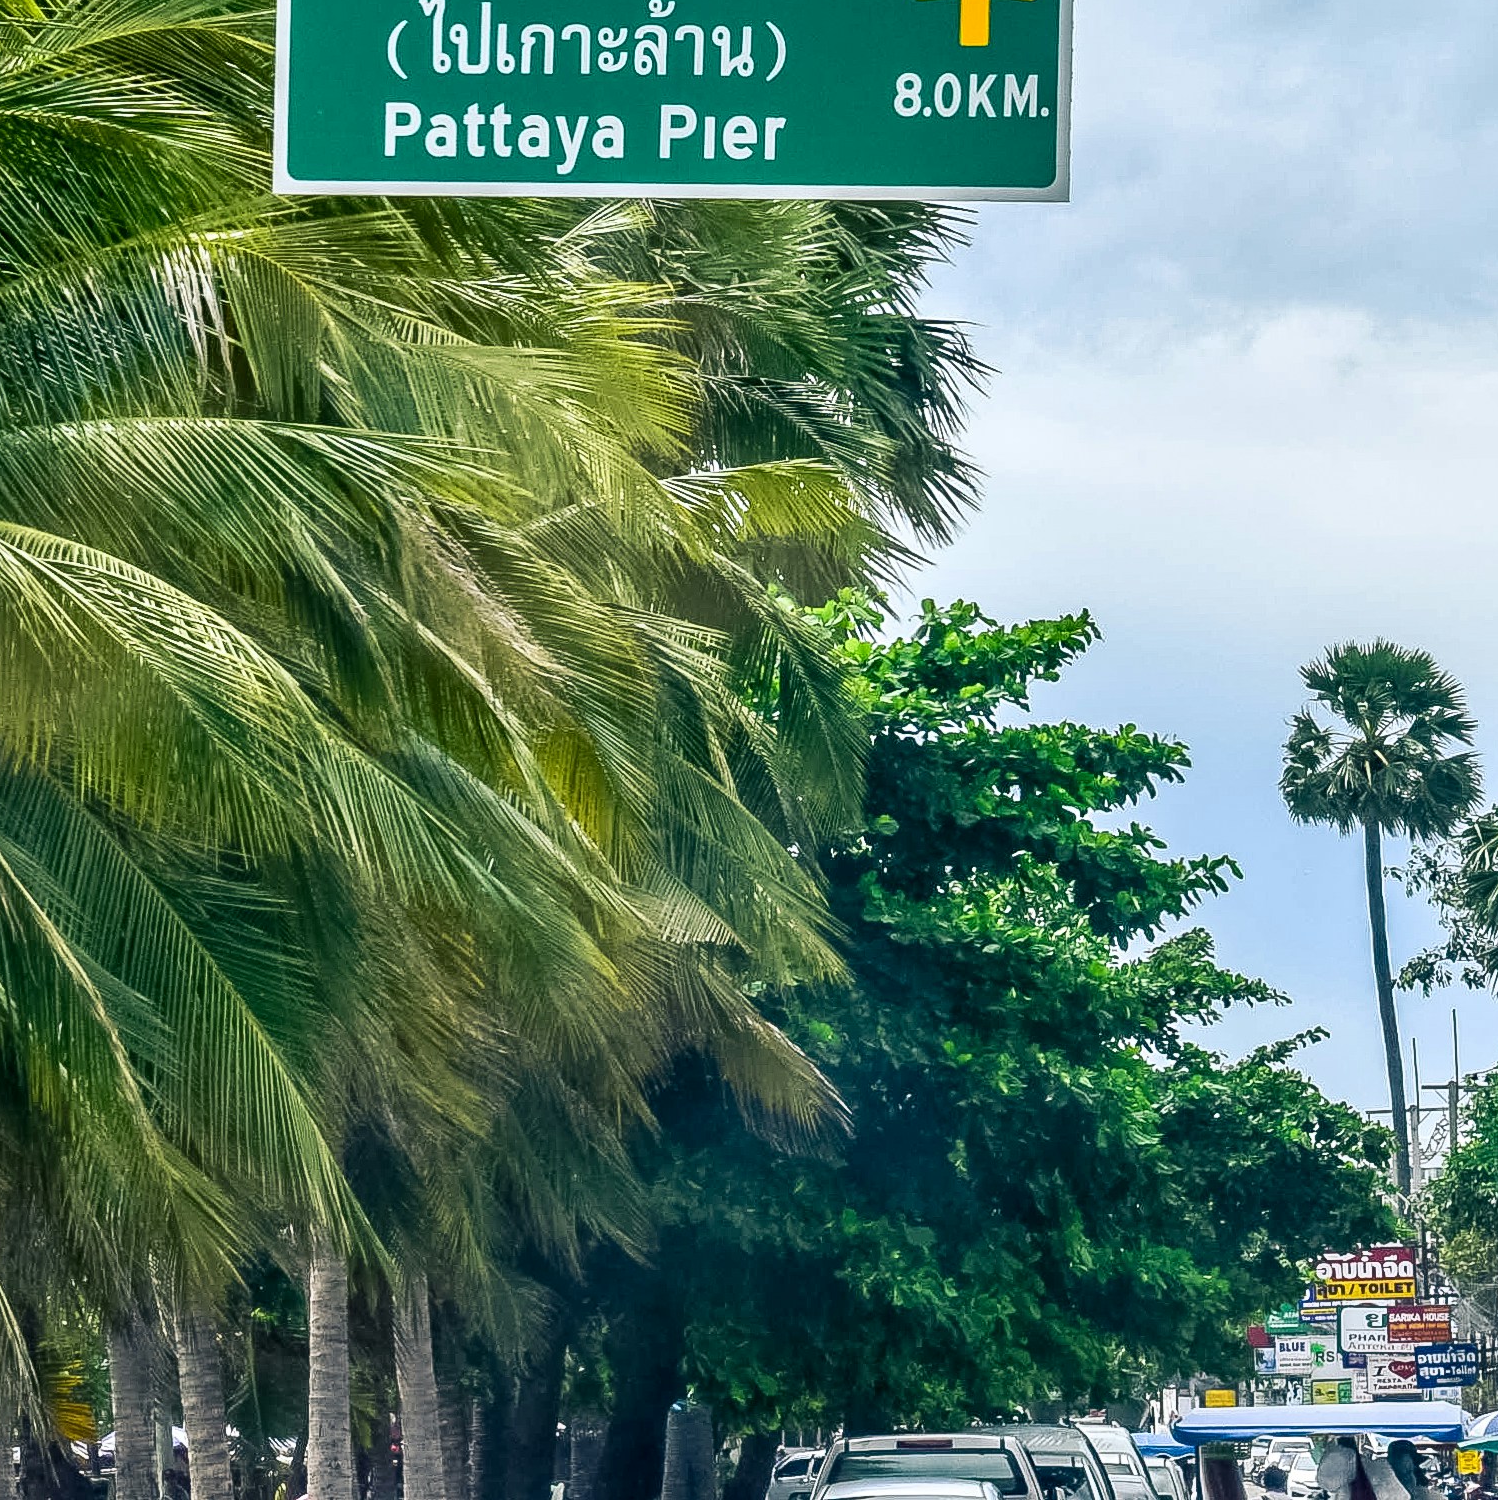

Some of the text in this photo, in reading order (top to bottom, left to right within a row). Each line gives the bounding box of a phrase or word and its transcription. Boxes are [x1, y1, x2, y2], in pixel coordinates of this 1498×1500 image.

[893, 73, 1050, 118] 8.0KM.
[383, 103, 786, 175] Pattaya Pier
[1359, 1282, 1413, 1295] TOILET
[1423, 1312, 1449, 1322] HOUSE
[1279, 1342, 1306, 1352] BLUE
